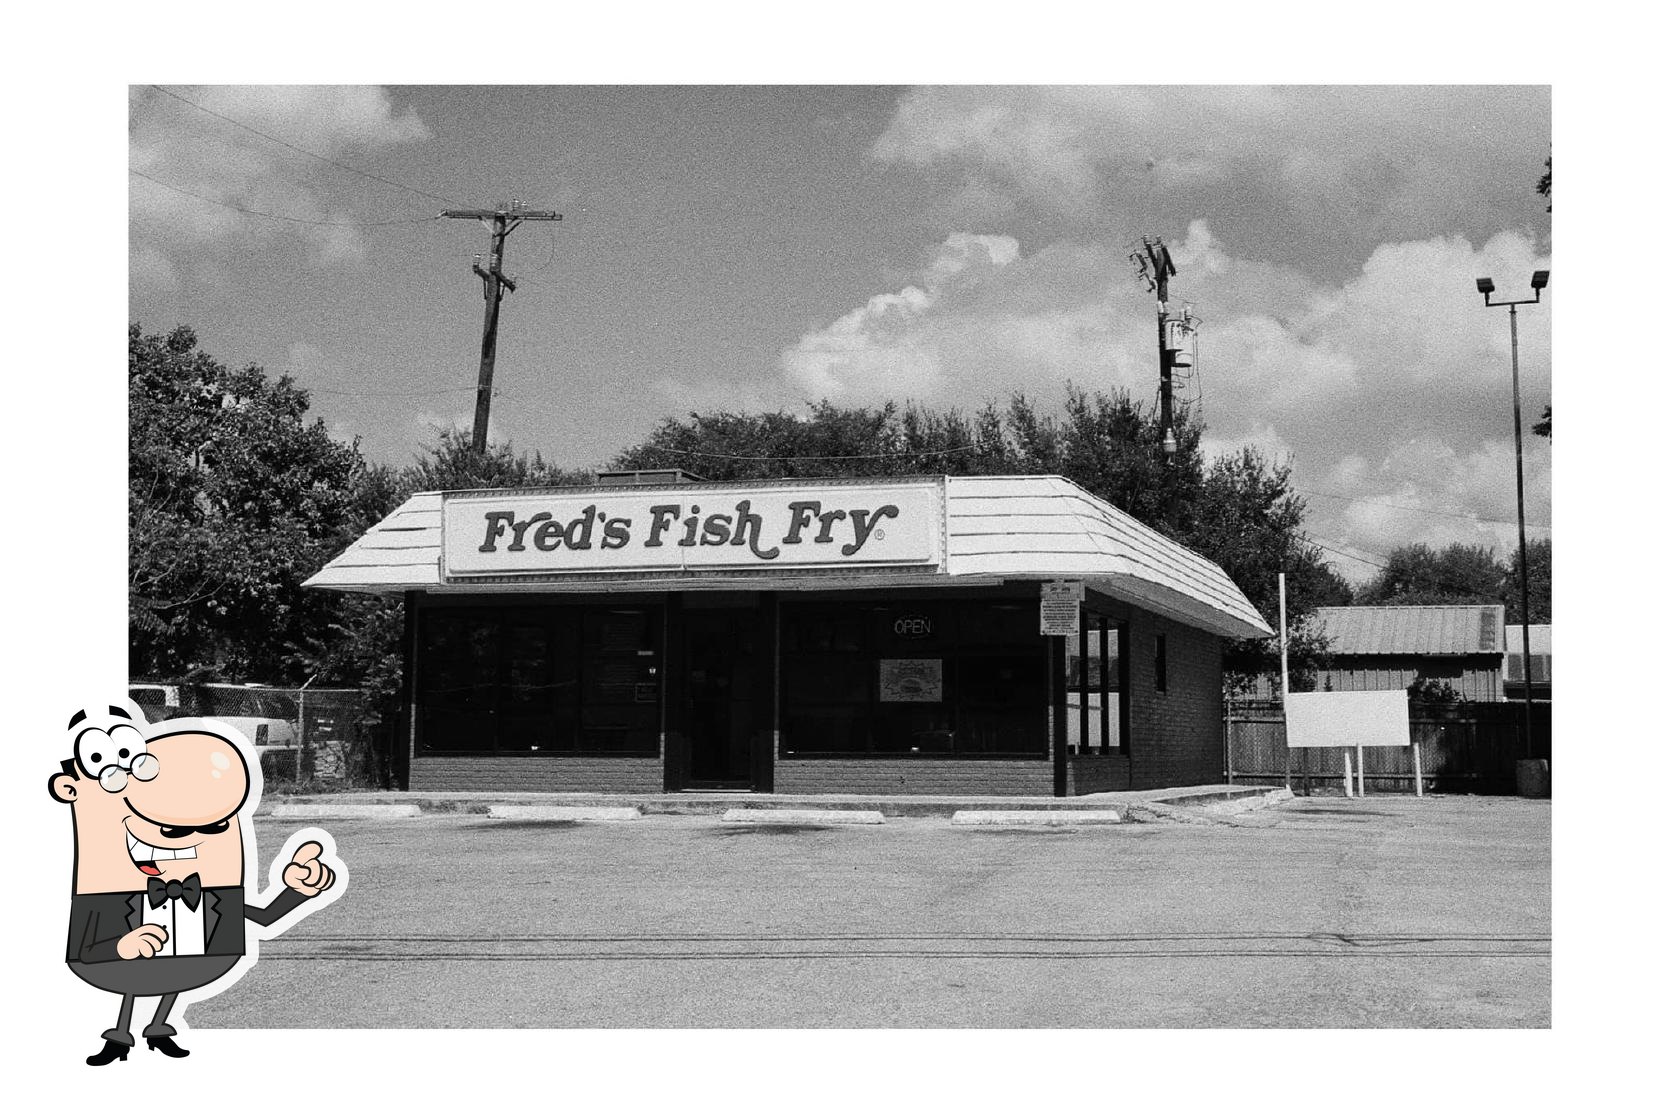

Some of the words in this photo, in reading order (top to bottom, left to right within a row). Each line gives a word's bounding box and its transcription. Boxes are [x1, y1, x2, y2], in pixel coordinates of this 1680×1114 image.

[479, 505, 632, 552] Fred's
[644, 500, 780, 559] Fish
[782, 500, 899, 556] Fry
[894, 619, 931, 634] OPEN
